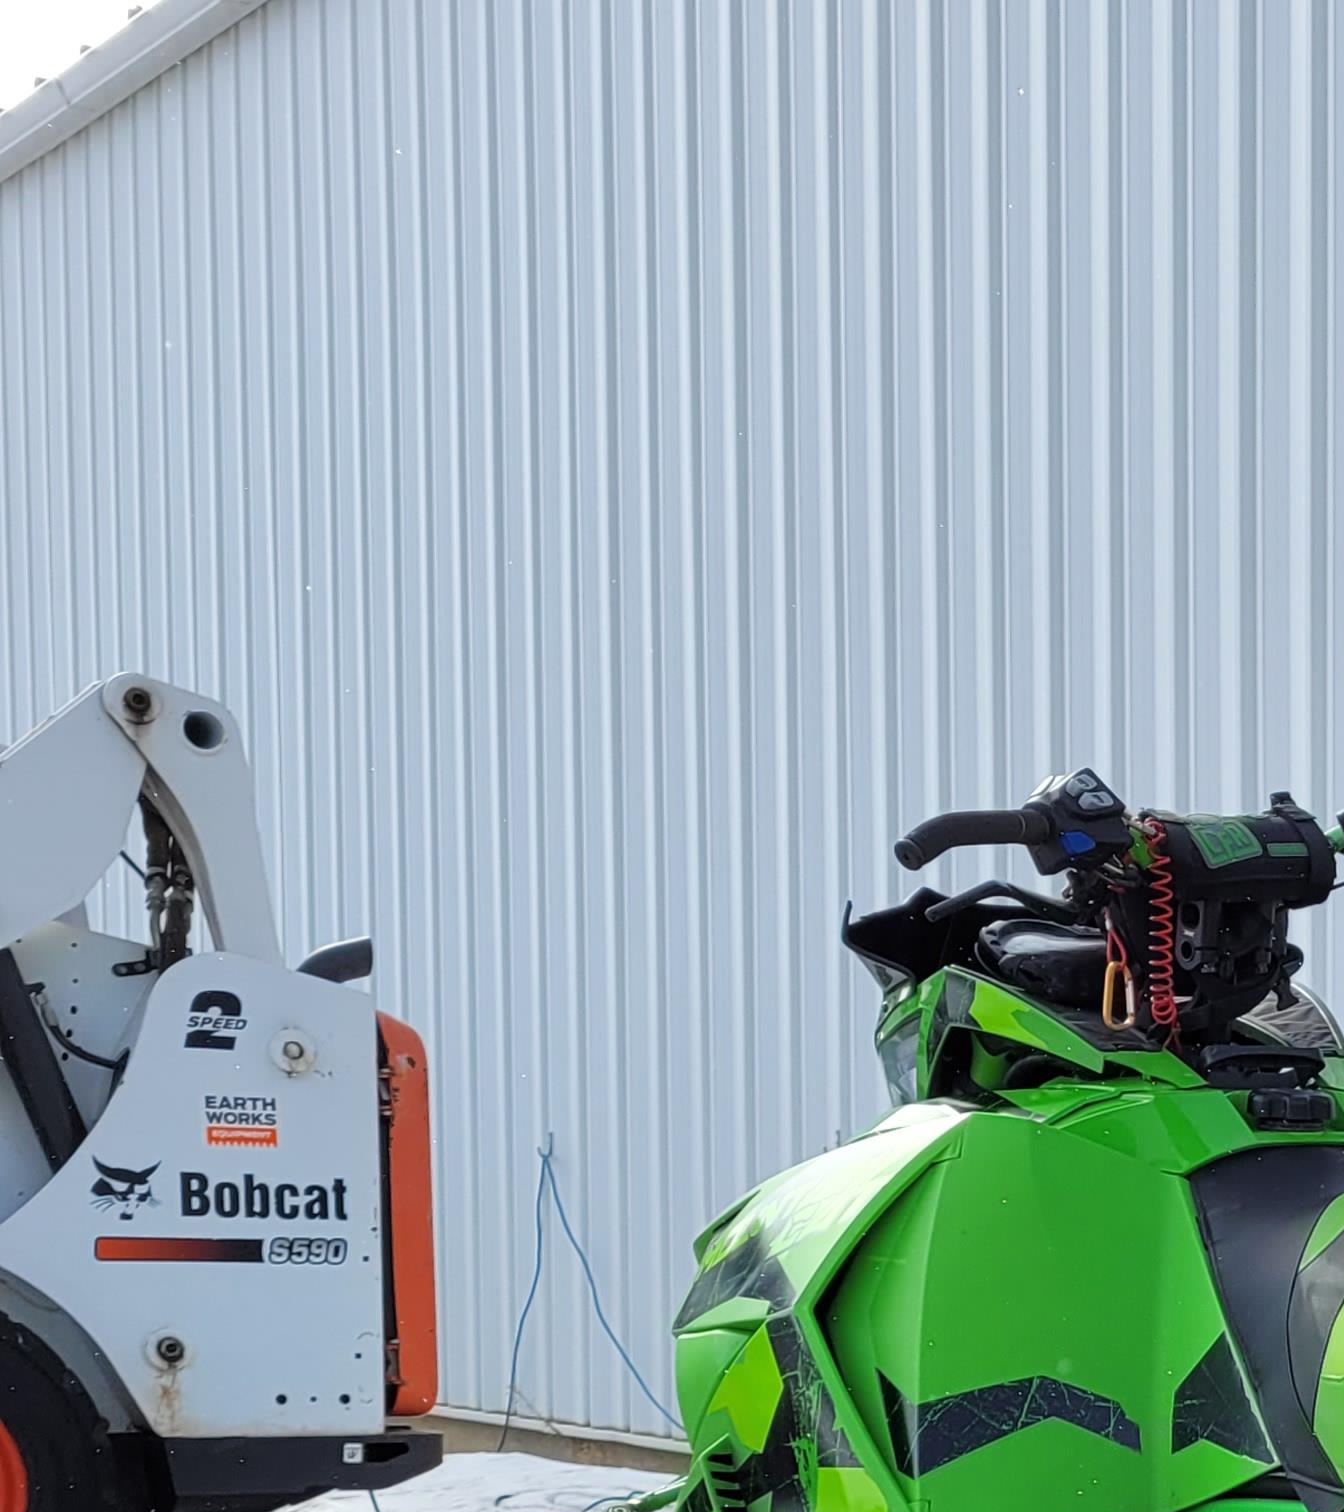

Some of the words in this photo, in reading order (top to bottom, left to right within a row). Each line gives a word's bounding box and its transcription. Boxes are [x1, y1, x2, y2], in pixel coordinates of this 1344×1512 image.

[184, 990, 242, 1051] 2
[186, 1015, 248, 1031] SPEED
[204, 1095, 277, 1111] EARTH
[205, 1111, 277, 1126] WORKS
[179, 1171, 349, 1221] Bobcat
[268, 1236, 348, 1266] S590
